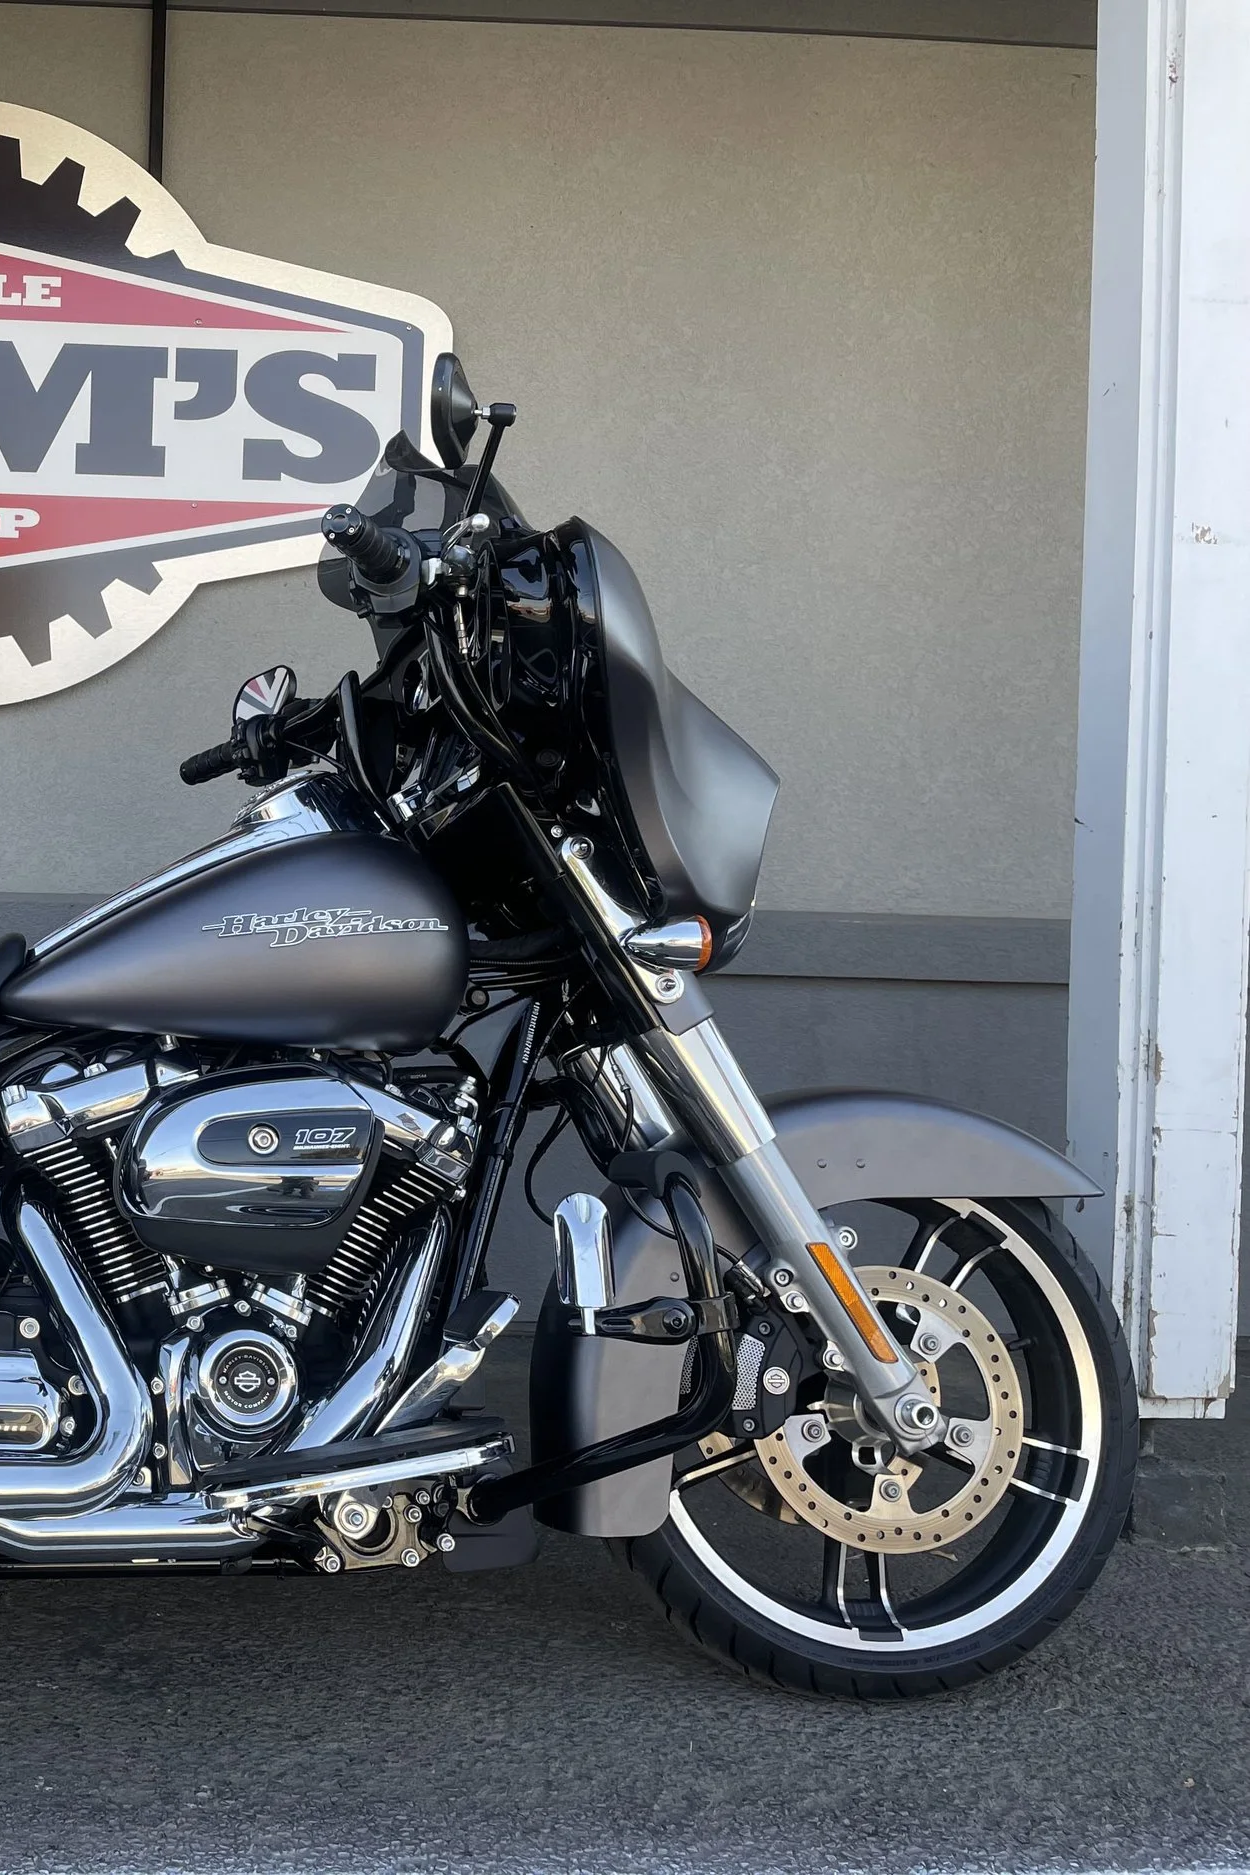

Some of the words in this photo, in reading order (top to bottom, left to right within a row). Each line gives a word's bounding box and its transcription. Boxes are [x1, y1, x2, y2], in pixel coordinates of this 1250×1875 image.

[202, 908, 371, 937] Harley
[257, 916, 448, 948] Davidson
[295, 1127, 356, 1144] 107
[224, 1390, 243, 1408] MOTOR
[243, 1391, 270, 1409] COMPANY
